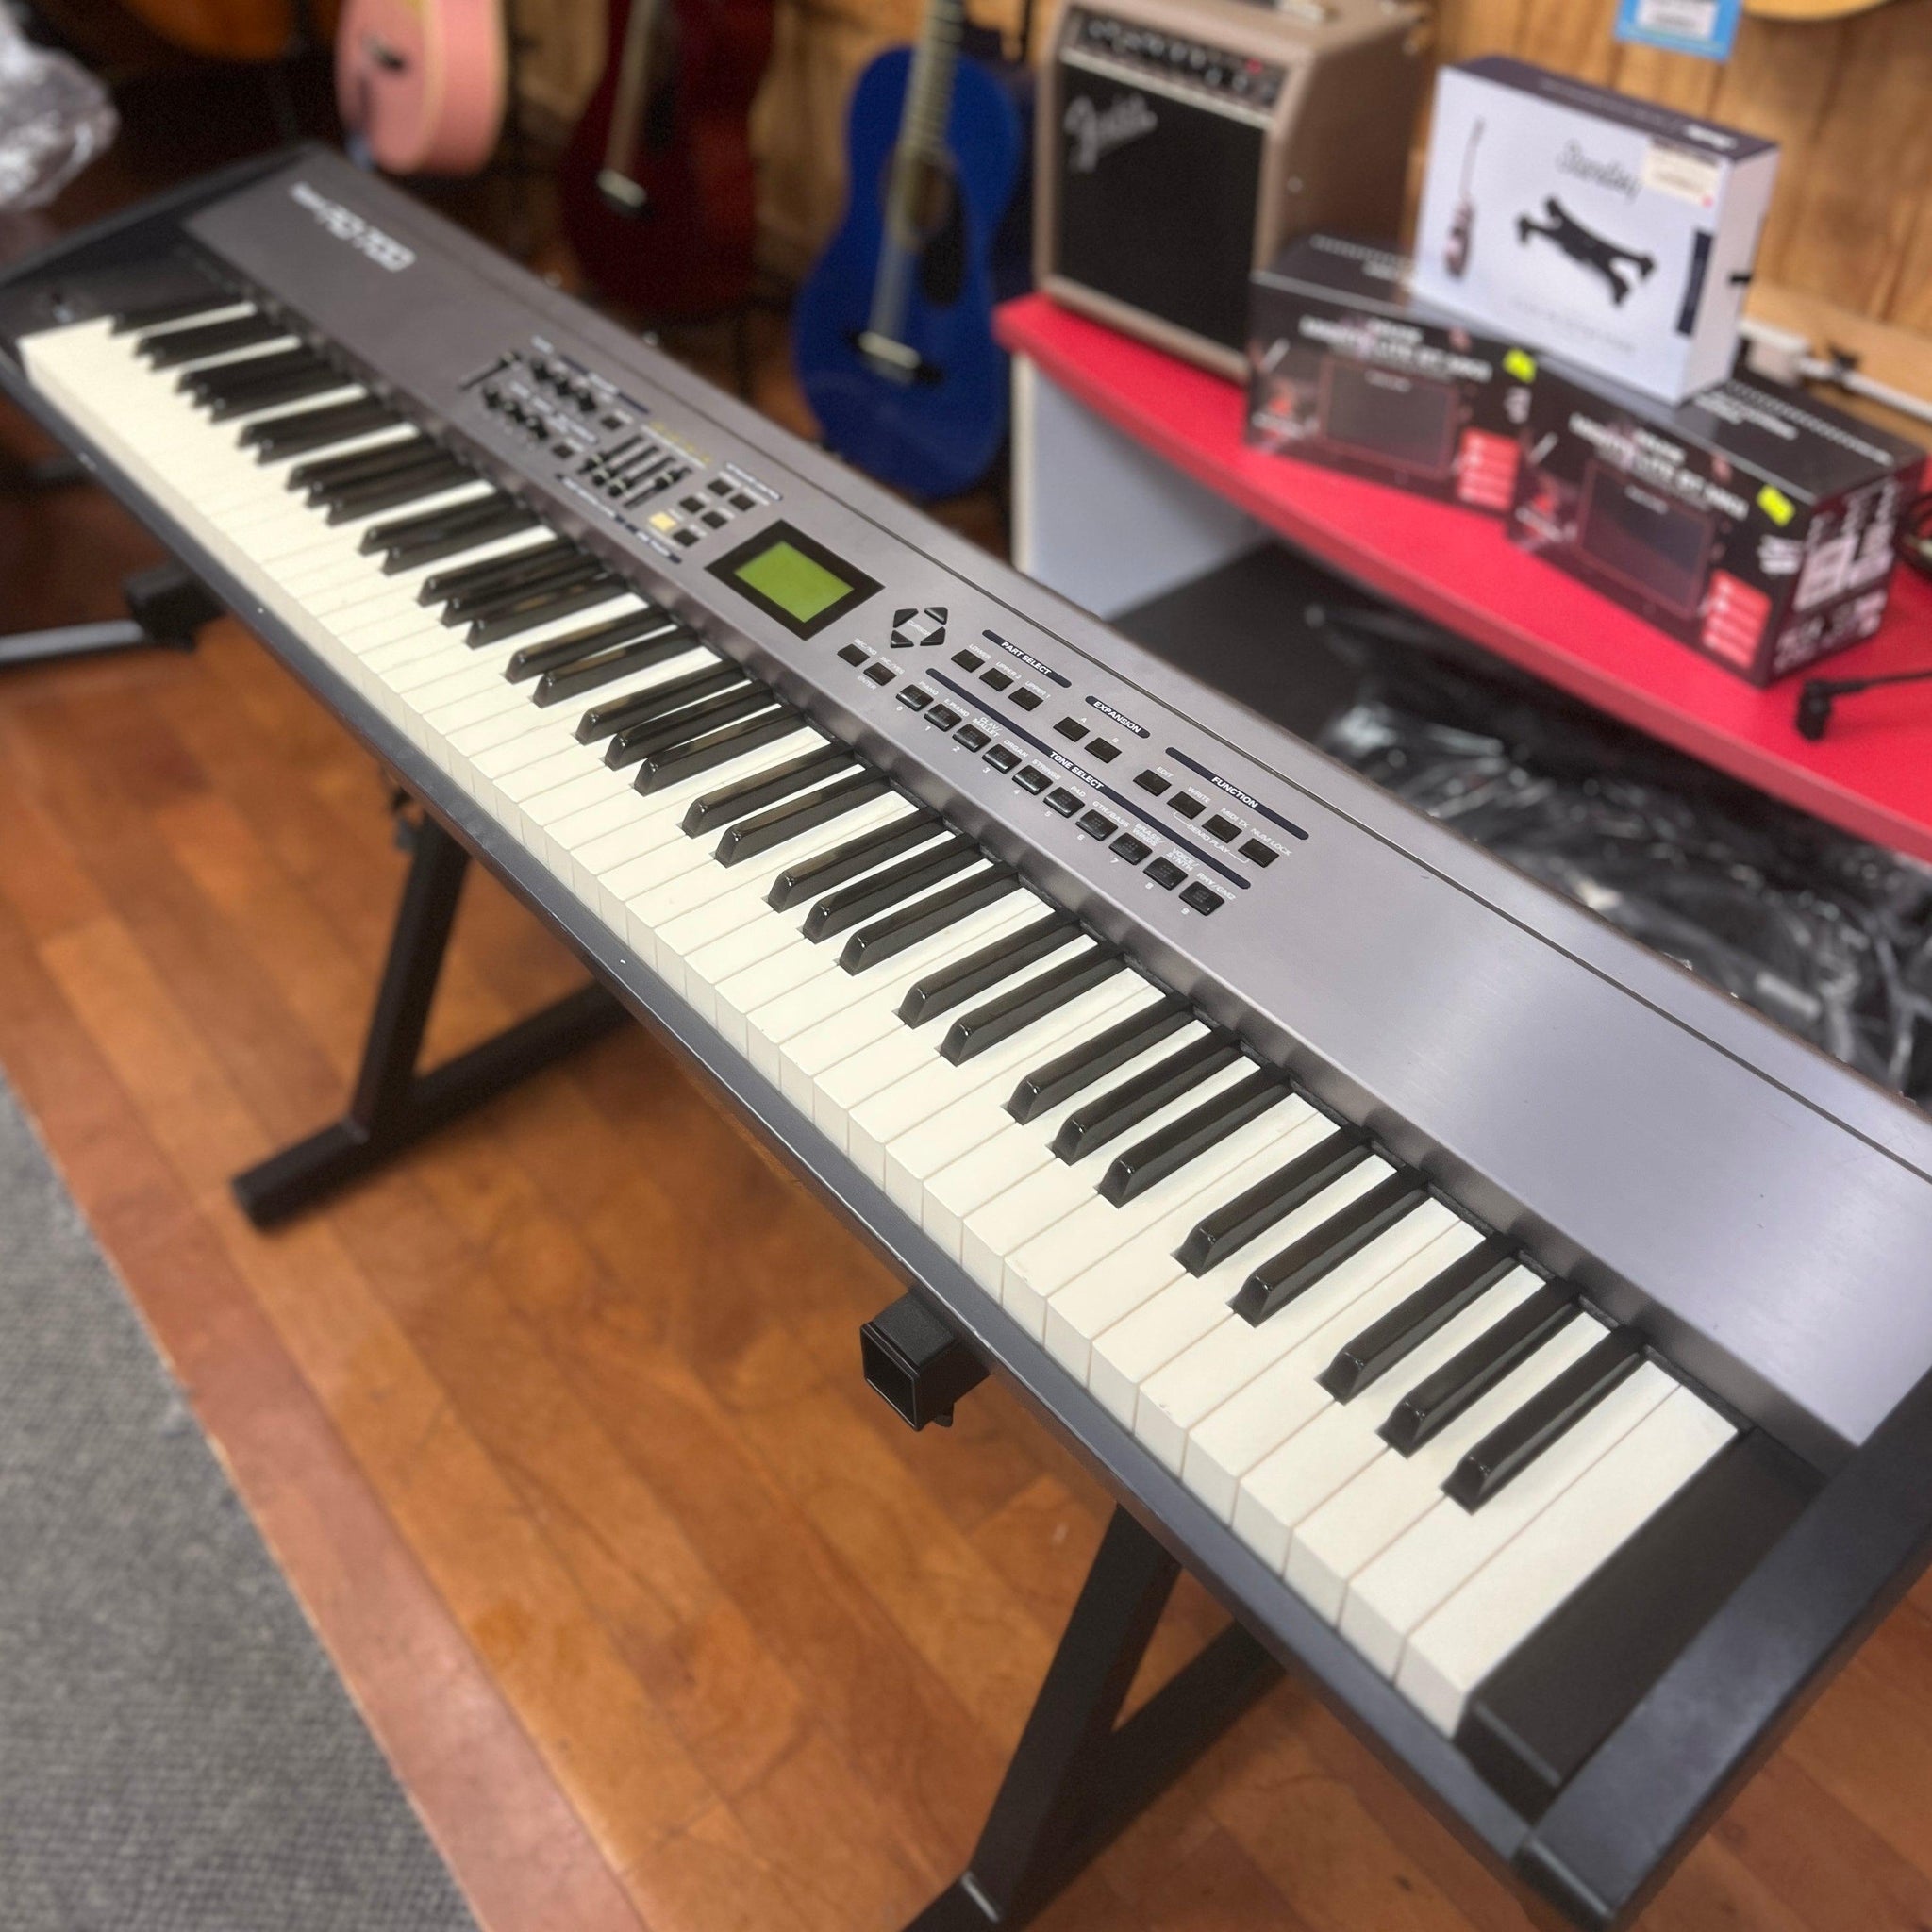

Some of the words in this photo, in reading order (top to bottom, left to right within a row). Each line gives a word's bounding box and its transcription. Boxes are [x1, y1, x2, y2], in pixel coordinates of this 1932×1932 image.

[907, 619, 932, 637] CURSOR
[854, 638, 877, 656] DEC/NO
[969, 643, 991, 660] LOWER
[1001, 641, 1024, 657] PART
[1021, 654, 1052, 675] SELECT
[995, 661, 1017, 677] UPPER
[857, 675, 877, 691] ENTER
[919, 680, 939, 696] PIANO
[1024, 680, 1047, 696] UPPER
[1093, 701, 1141, 733] EXPANSION
[972, 718, 1000, 737] MALLET
[1003, 740, 1029, 758] ORGAN
[1032, 758, 1061, 781] STRINGS
[1050, 751, 1074, 770] TONE
[1071, 767, 1105, 790] SELECT
[1156, 766, 1174, 778] EDIT
[1070, 785, 1086, 798] PAD
[1187, 786, 1211, 804] WRITE
[1211, 776, 1259, 808] FUNCTION
[1092, 800, 1130, 828] GTR/BASS
[1220, 808, 1240, 822] MIDI
[1237, 818, 1250, 829] TX
[1188, 824, 1211, 841] DEMO
[1208, 839, 1231, 854] PLAY
[1251, 827, 1272, 843] NUM
[1269, 840, 1292, 856] LOCK
[1166, 850, 1194, 872] SYNTH
